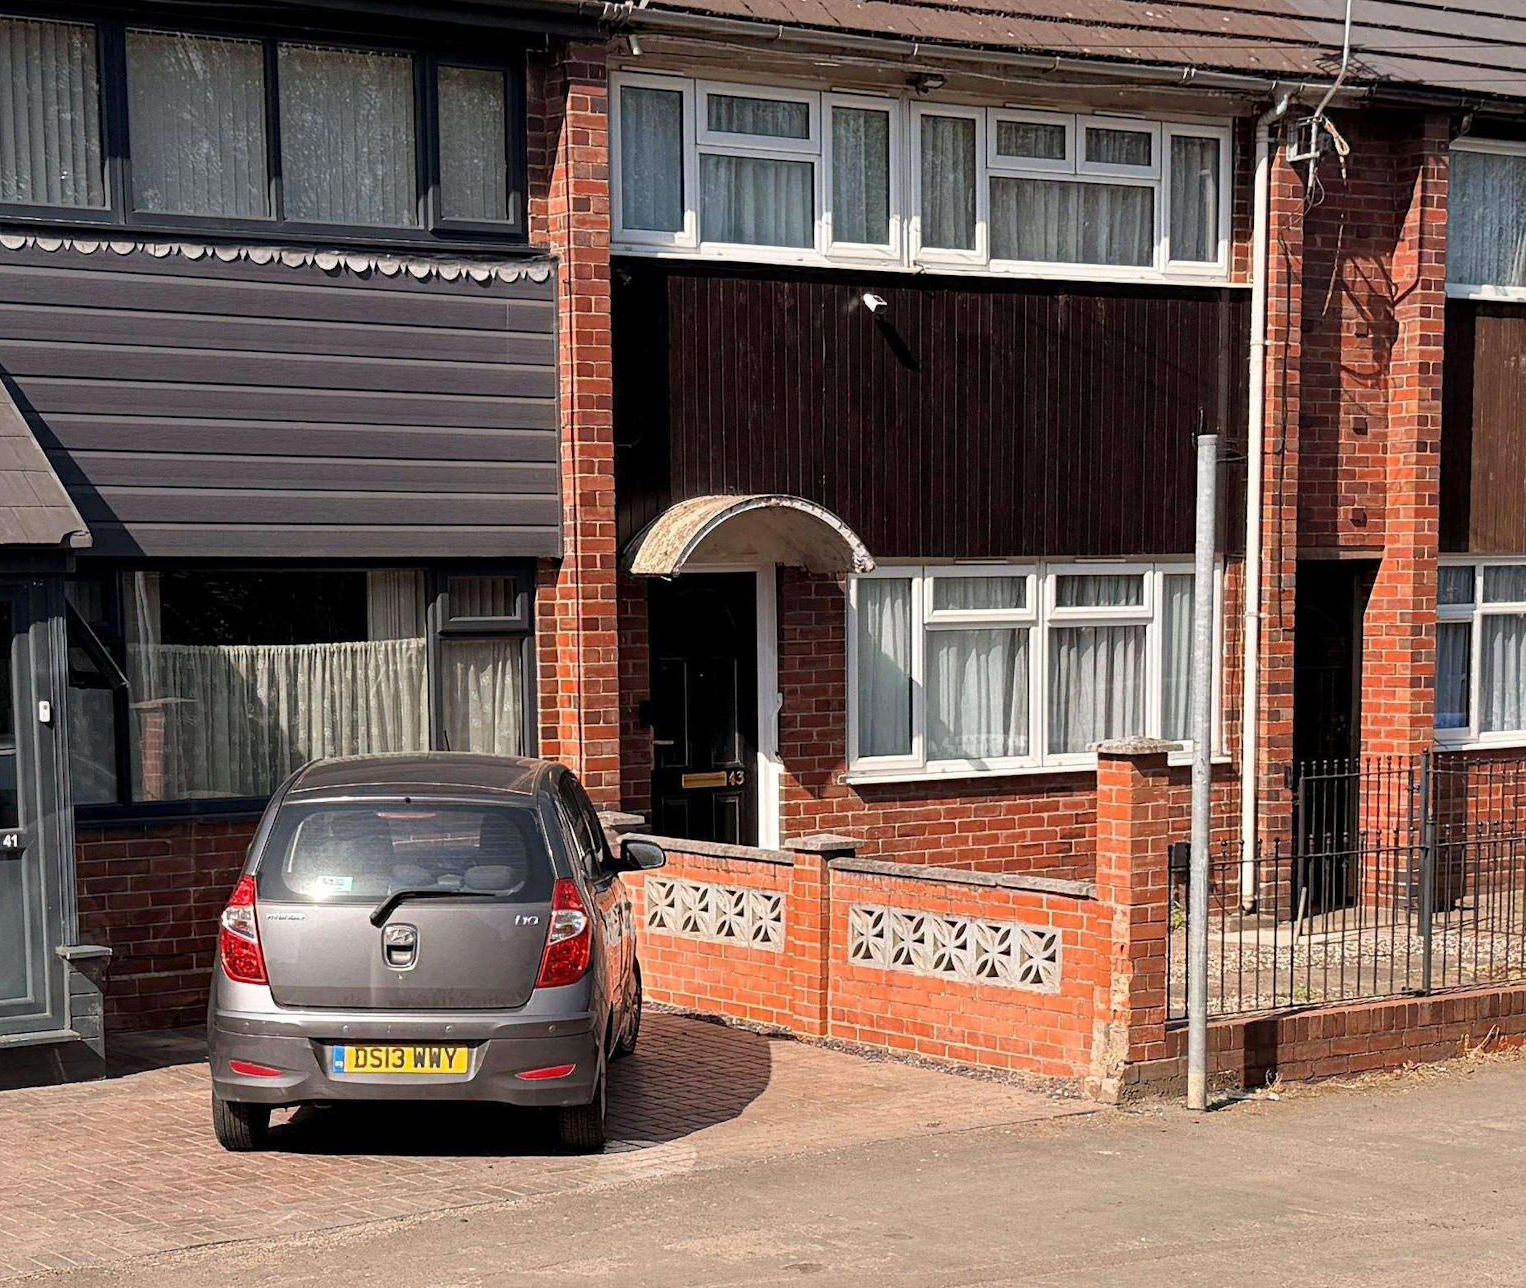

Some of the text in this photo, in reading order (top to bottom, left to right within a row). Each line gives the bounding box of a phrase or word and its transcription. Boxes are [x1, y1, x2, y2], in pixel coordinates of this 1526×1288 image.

[729, 770, 745, 786] 43
[2, 833, 18, 848] 41
[353, 1047, 457, 1069] DS13 WWY
